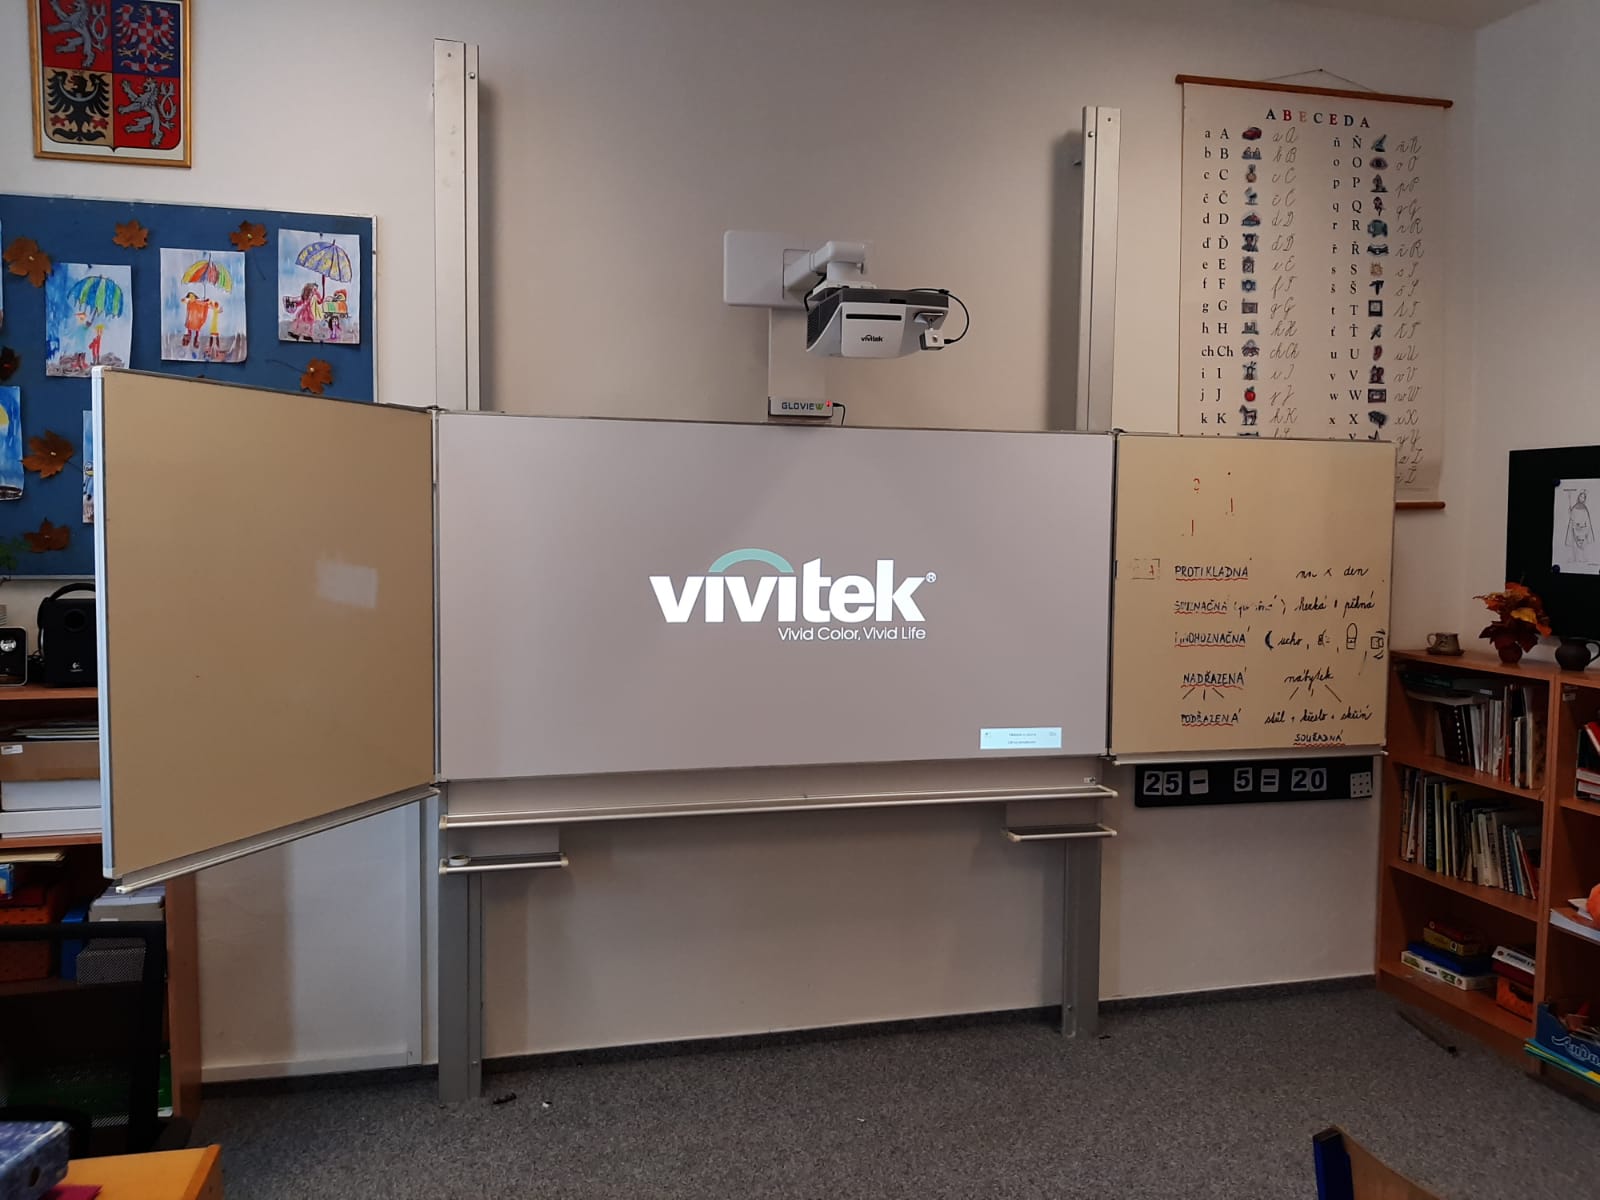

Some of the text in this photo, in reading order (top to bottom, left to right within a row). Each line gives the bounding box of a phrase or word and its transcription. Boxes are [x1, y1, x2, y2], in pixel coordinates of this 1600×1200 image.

[1220, 129, 1229, 139] A
[1352, 135, 1362, 149] Ň
[1205, 147, 1211, 158] b
[1221, 148, 1228, 159] B
[1352, 157, 1362, 168] O
[1220, 170, 1228, 180] C
[1333, 179, 1340, 189] p
[1352, 177, 1360, 188] P
[1219, 191, 1228, 204] Č
[1333, 203, 1339, 212] q
[1352, 201, 1362, 214] Q
[1203, 213, 1210, 224] d
[1220, 214, 1229, 224] D
[1352, 220, 1360, 230] R
[1218, 236, 1228, 249] Ď
[1352, 241, 1360, 254] Ř
[1219, 259, 1226, 269] E
[1351, 264, 1357, 275] S
[1219, 279, 1225, 289] F
[1350, 281, 1357, 294] Š
[1202, 303, 1208, 313] g
[1218, 300, 1228, 311] G
[1350, 305, 1358, 315] T
[1202, 322, 1208, 333] h
[1218, 323, 1228, 334] H
[1202, 346, 1214, 356] ch
[1218, 346, 1233, 357] Ch
[1350, 349, 1359, 359] U
[1349, 370, 1358, 380] V
[1216, 388, 1221, 402] J
[1349, 390, 1362, 401] W
[781, 402, 824, 410] GLOVIEW
[1201, 413, 1208, 424] k
[1218, 414, 1226, 424] K
[1349, 414, 1358, 424] X
[778, 627, 926, 641] Vivid Color, Vivid Life
[1145, 775, 1180, 794] 25
[1236, 768, 1250, 789] 5
[1294, 768, 1324, 790] 20
